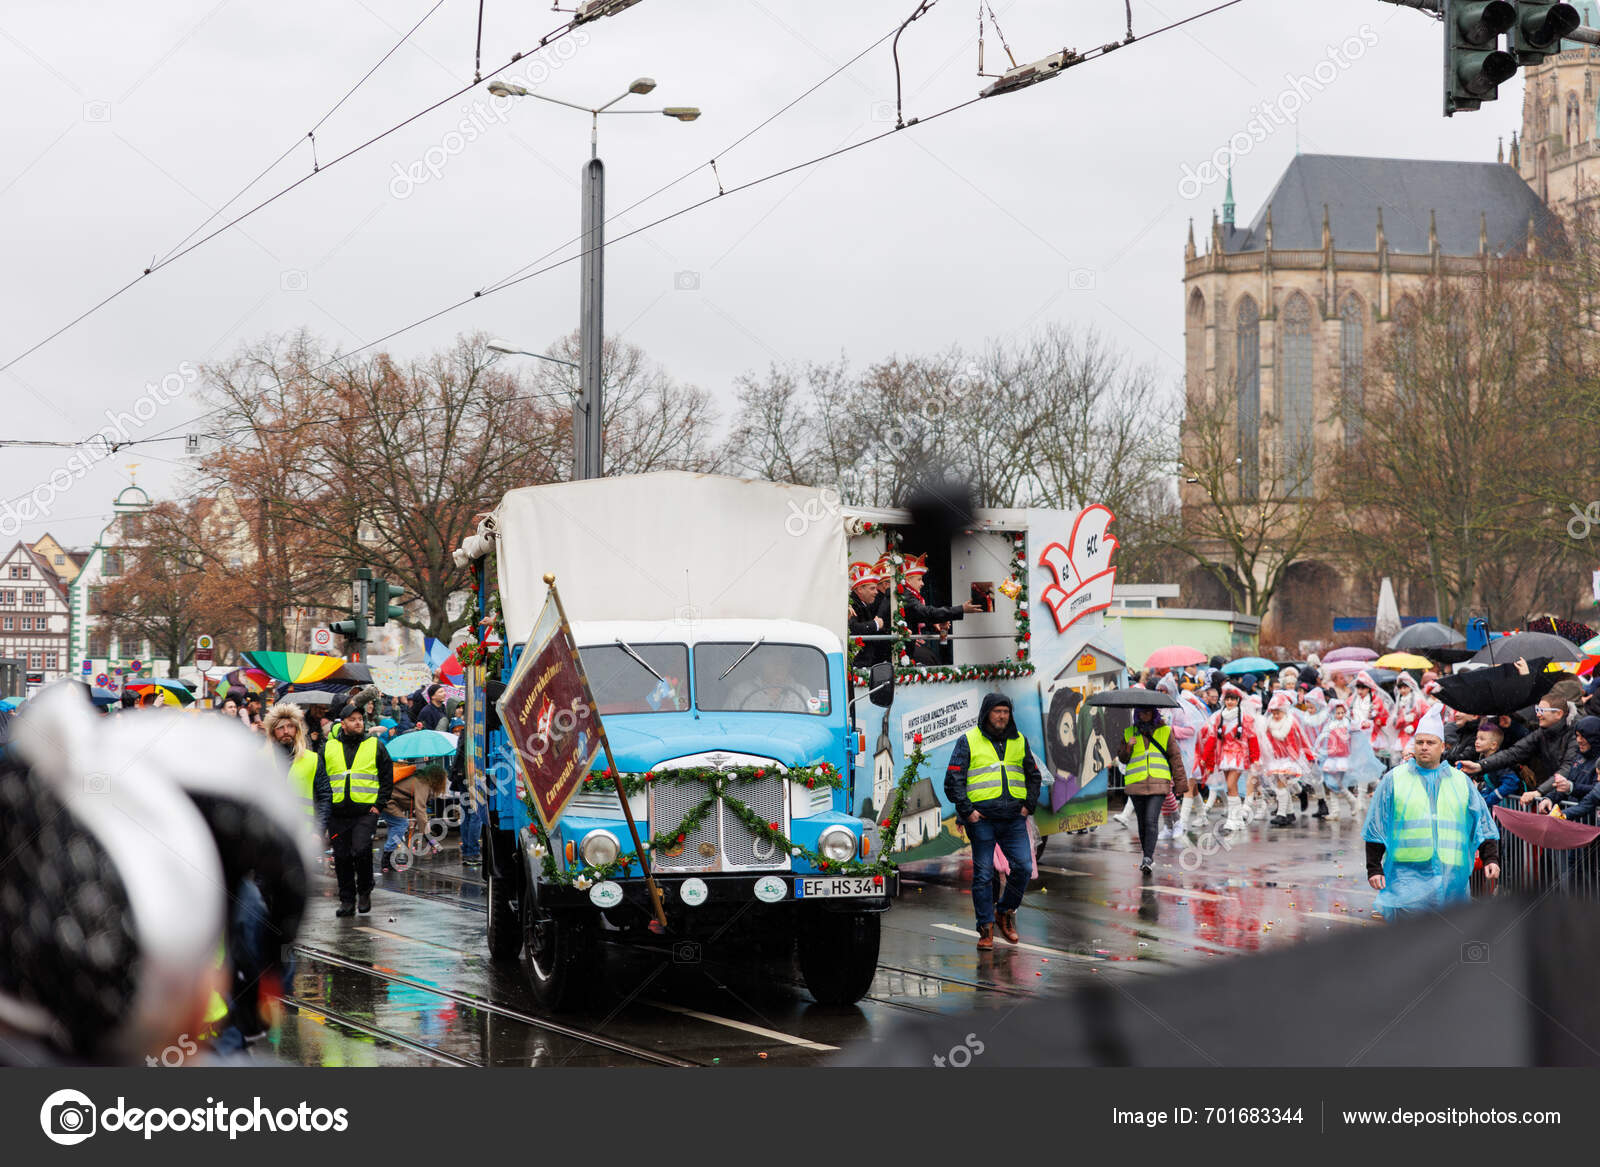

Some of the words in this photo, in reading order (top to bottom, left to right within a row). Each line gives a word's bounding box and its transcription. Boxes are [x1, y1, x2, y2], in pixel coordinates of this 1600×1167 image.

[188, 434, 198, 446] H
[1087, 534, 1098, 558] SCC
[318, 632, 328, 641] 20
[804, 881, 824, 896] EF
[832, 880, 851, 895] HS
